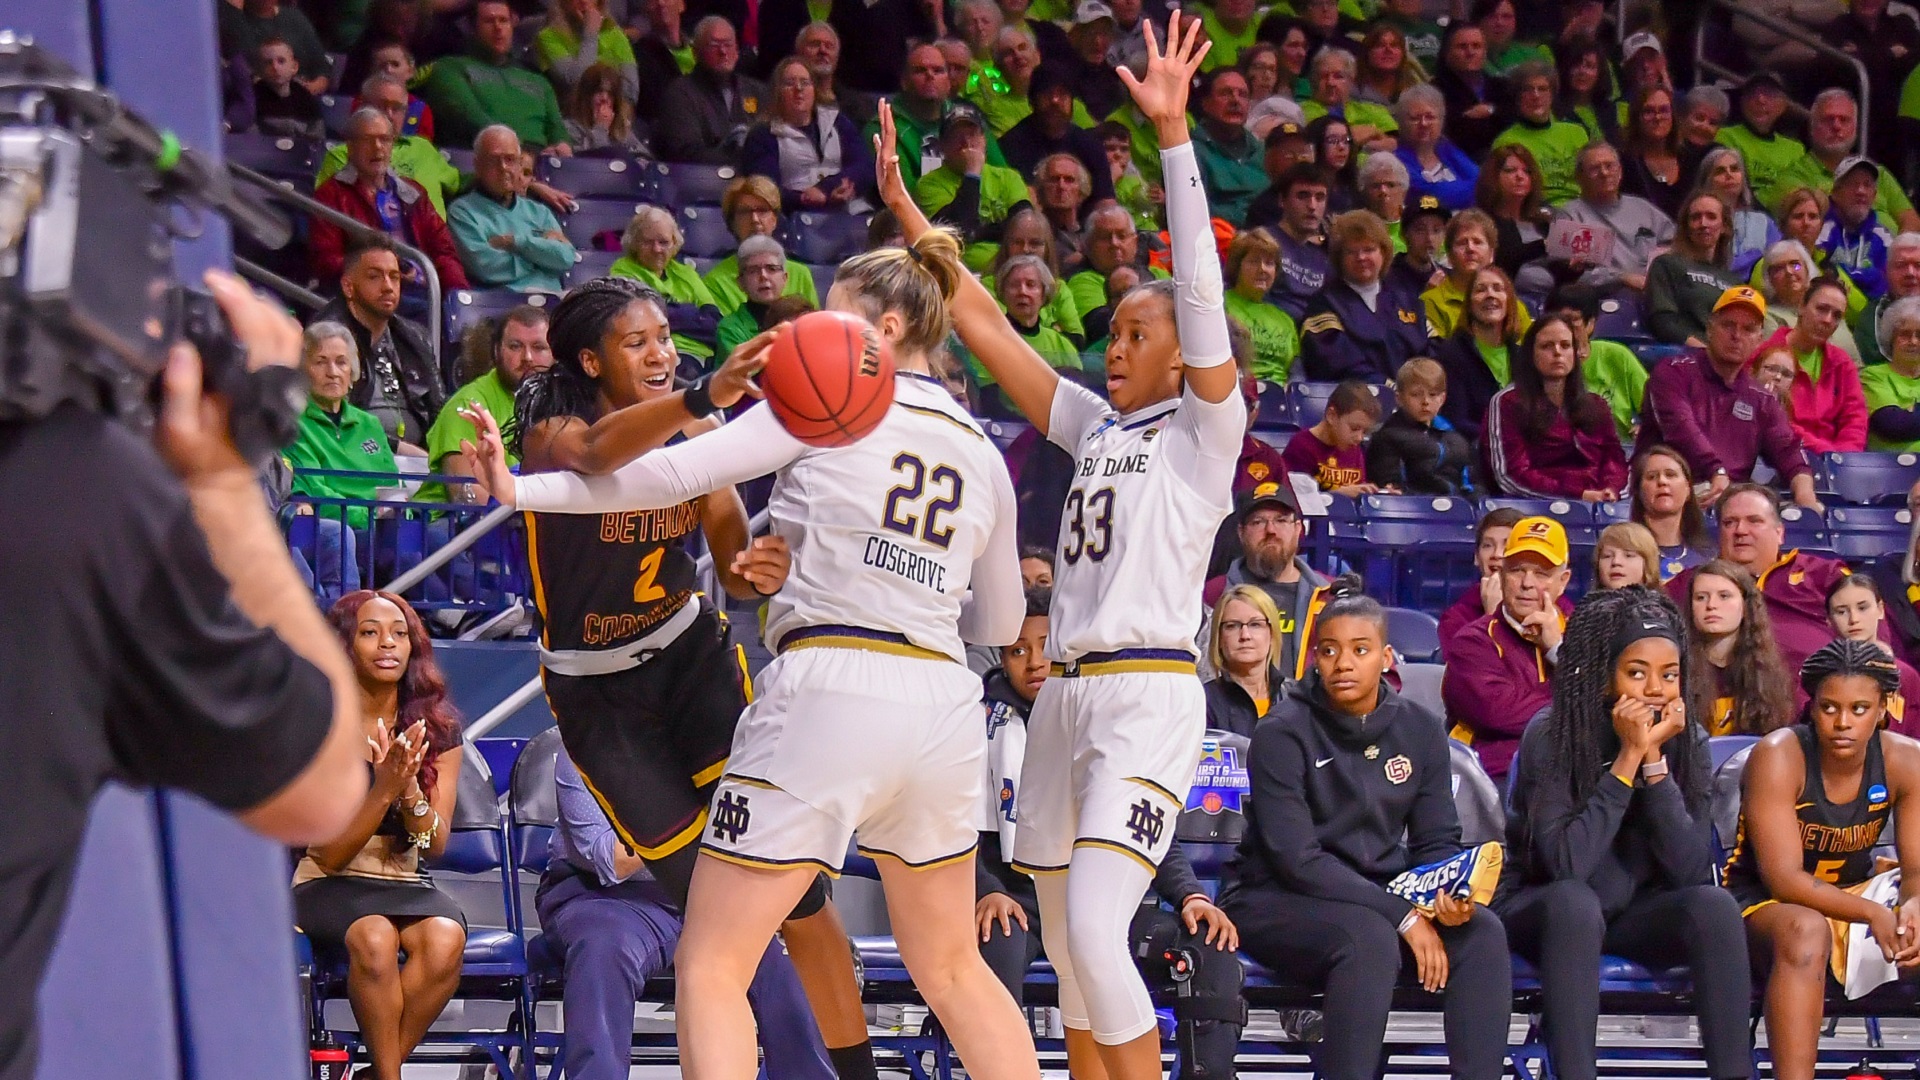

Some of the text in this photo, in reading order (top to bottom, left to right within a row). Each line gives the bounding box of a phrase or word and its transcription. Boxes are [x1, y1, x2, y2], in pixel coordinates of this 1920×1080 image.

[1102, 454, 1149, 477] DAME
[880, 450, 964, 551] 22
[1064, 486, 1116, 564] 33
[634, 547, 666, 603] 2
[863, 536, 946, 594] COSGROVE
[1198, 765, 1221, 775] IRST
